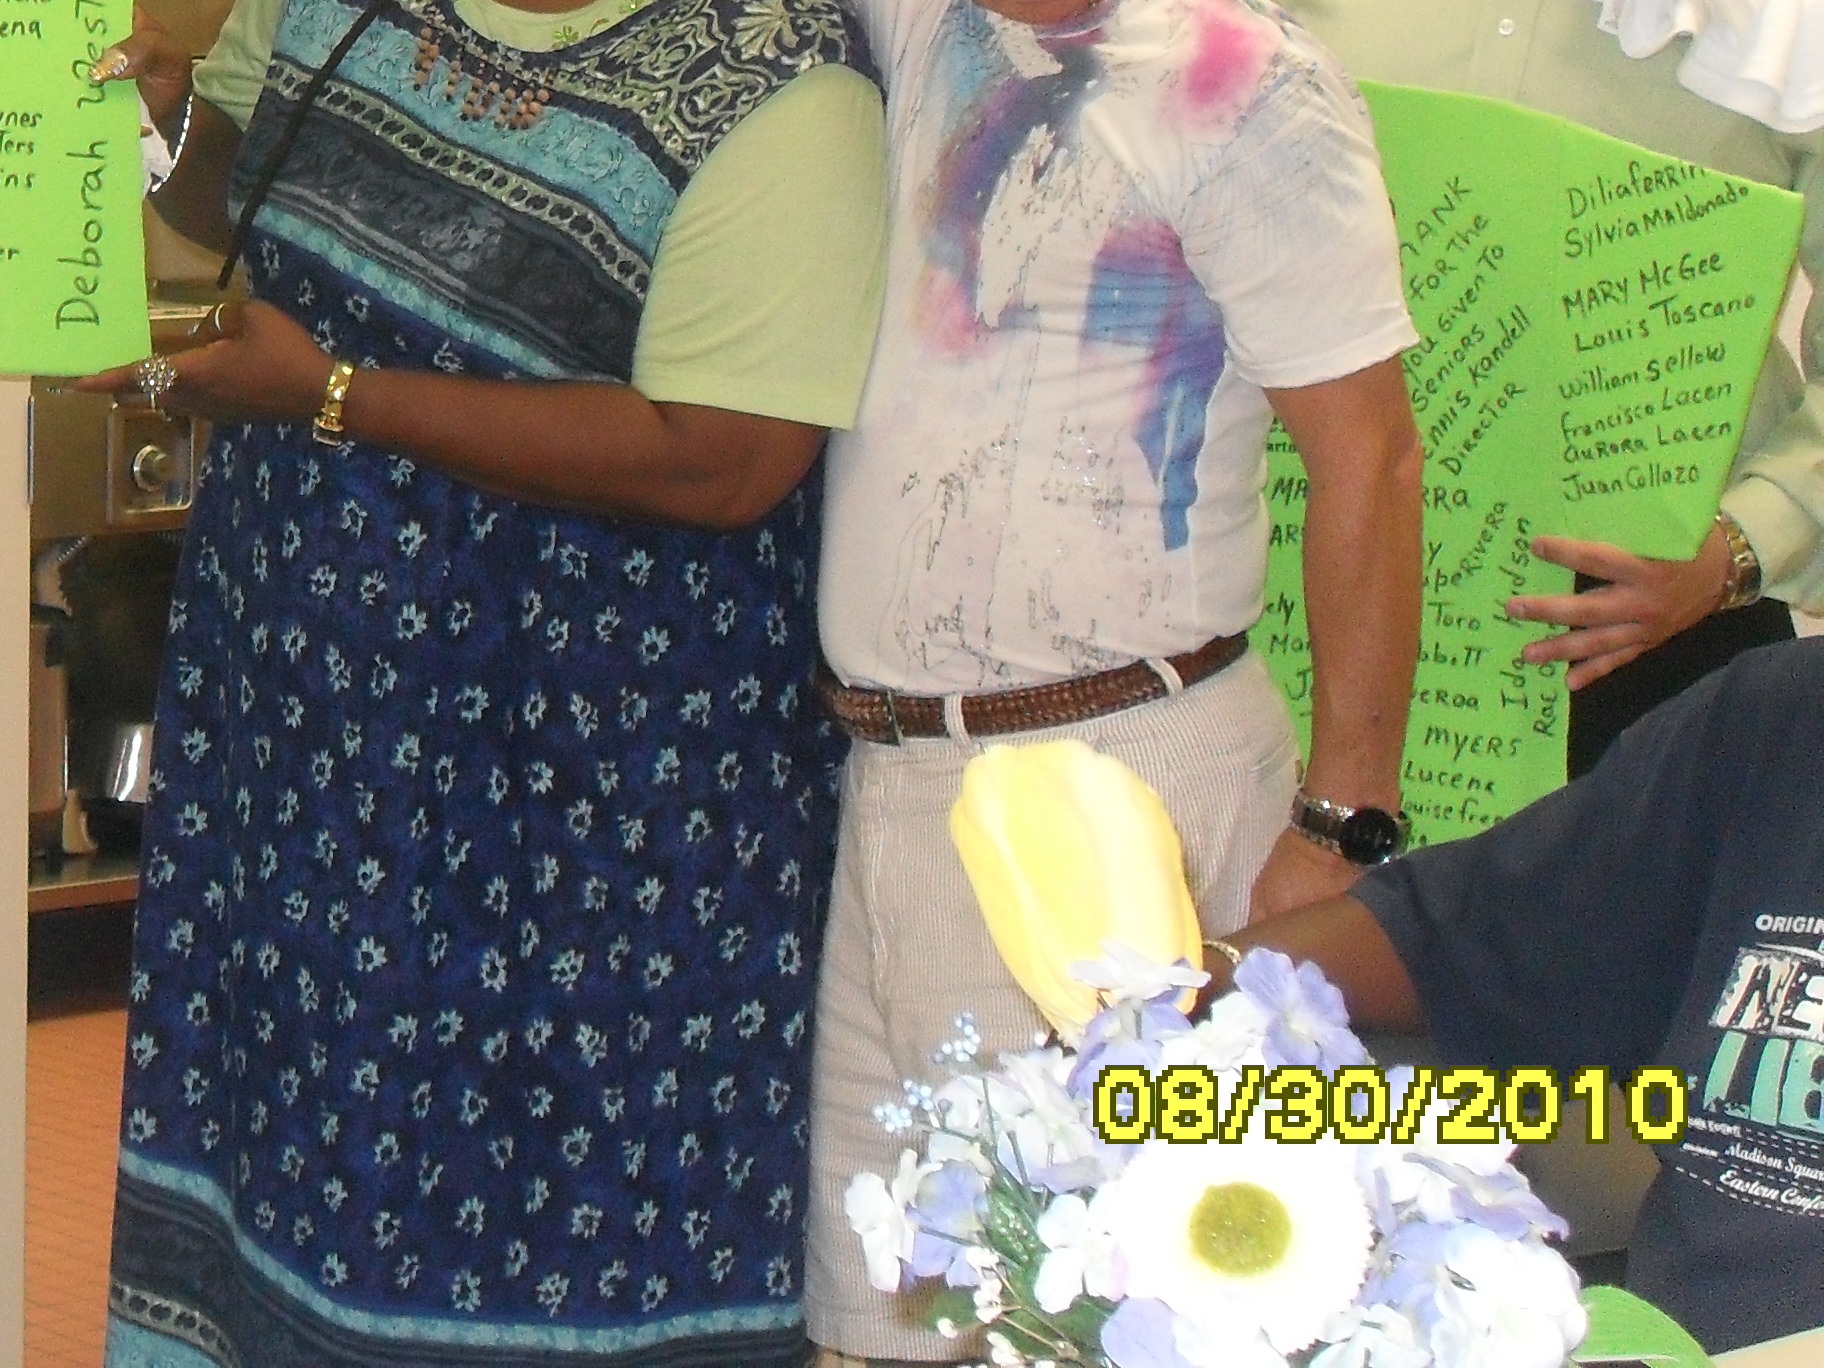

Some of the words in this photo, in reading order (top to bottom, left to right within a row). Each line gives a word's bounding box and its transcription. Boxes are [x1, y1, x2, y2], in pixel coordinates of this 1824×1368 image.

[54, 138, 110, 332] Deborah
[1724, 1142, 1783, 1170] Madison
[1719, 1169, 1780, 1201] Eastern
